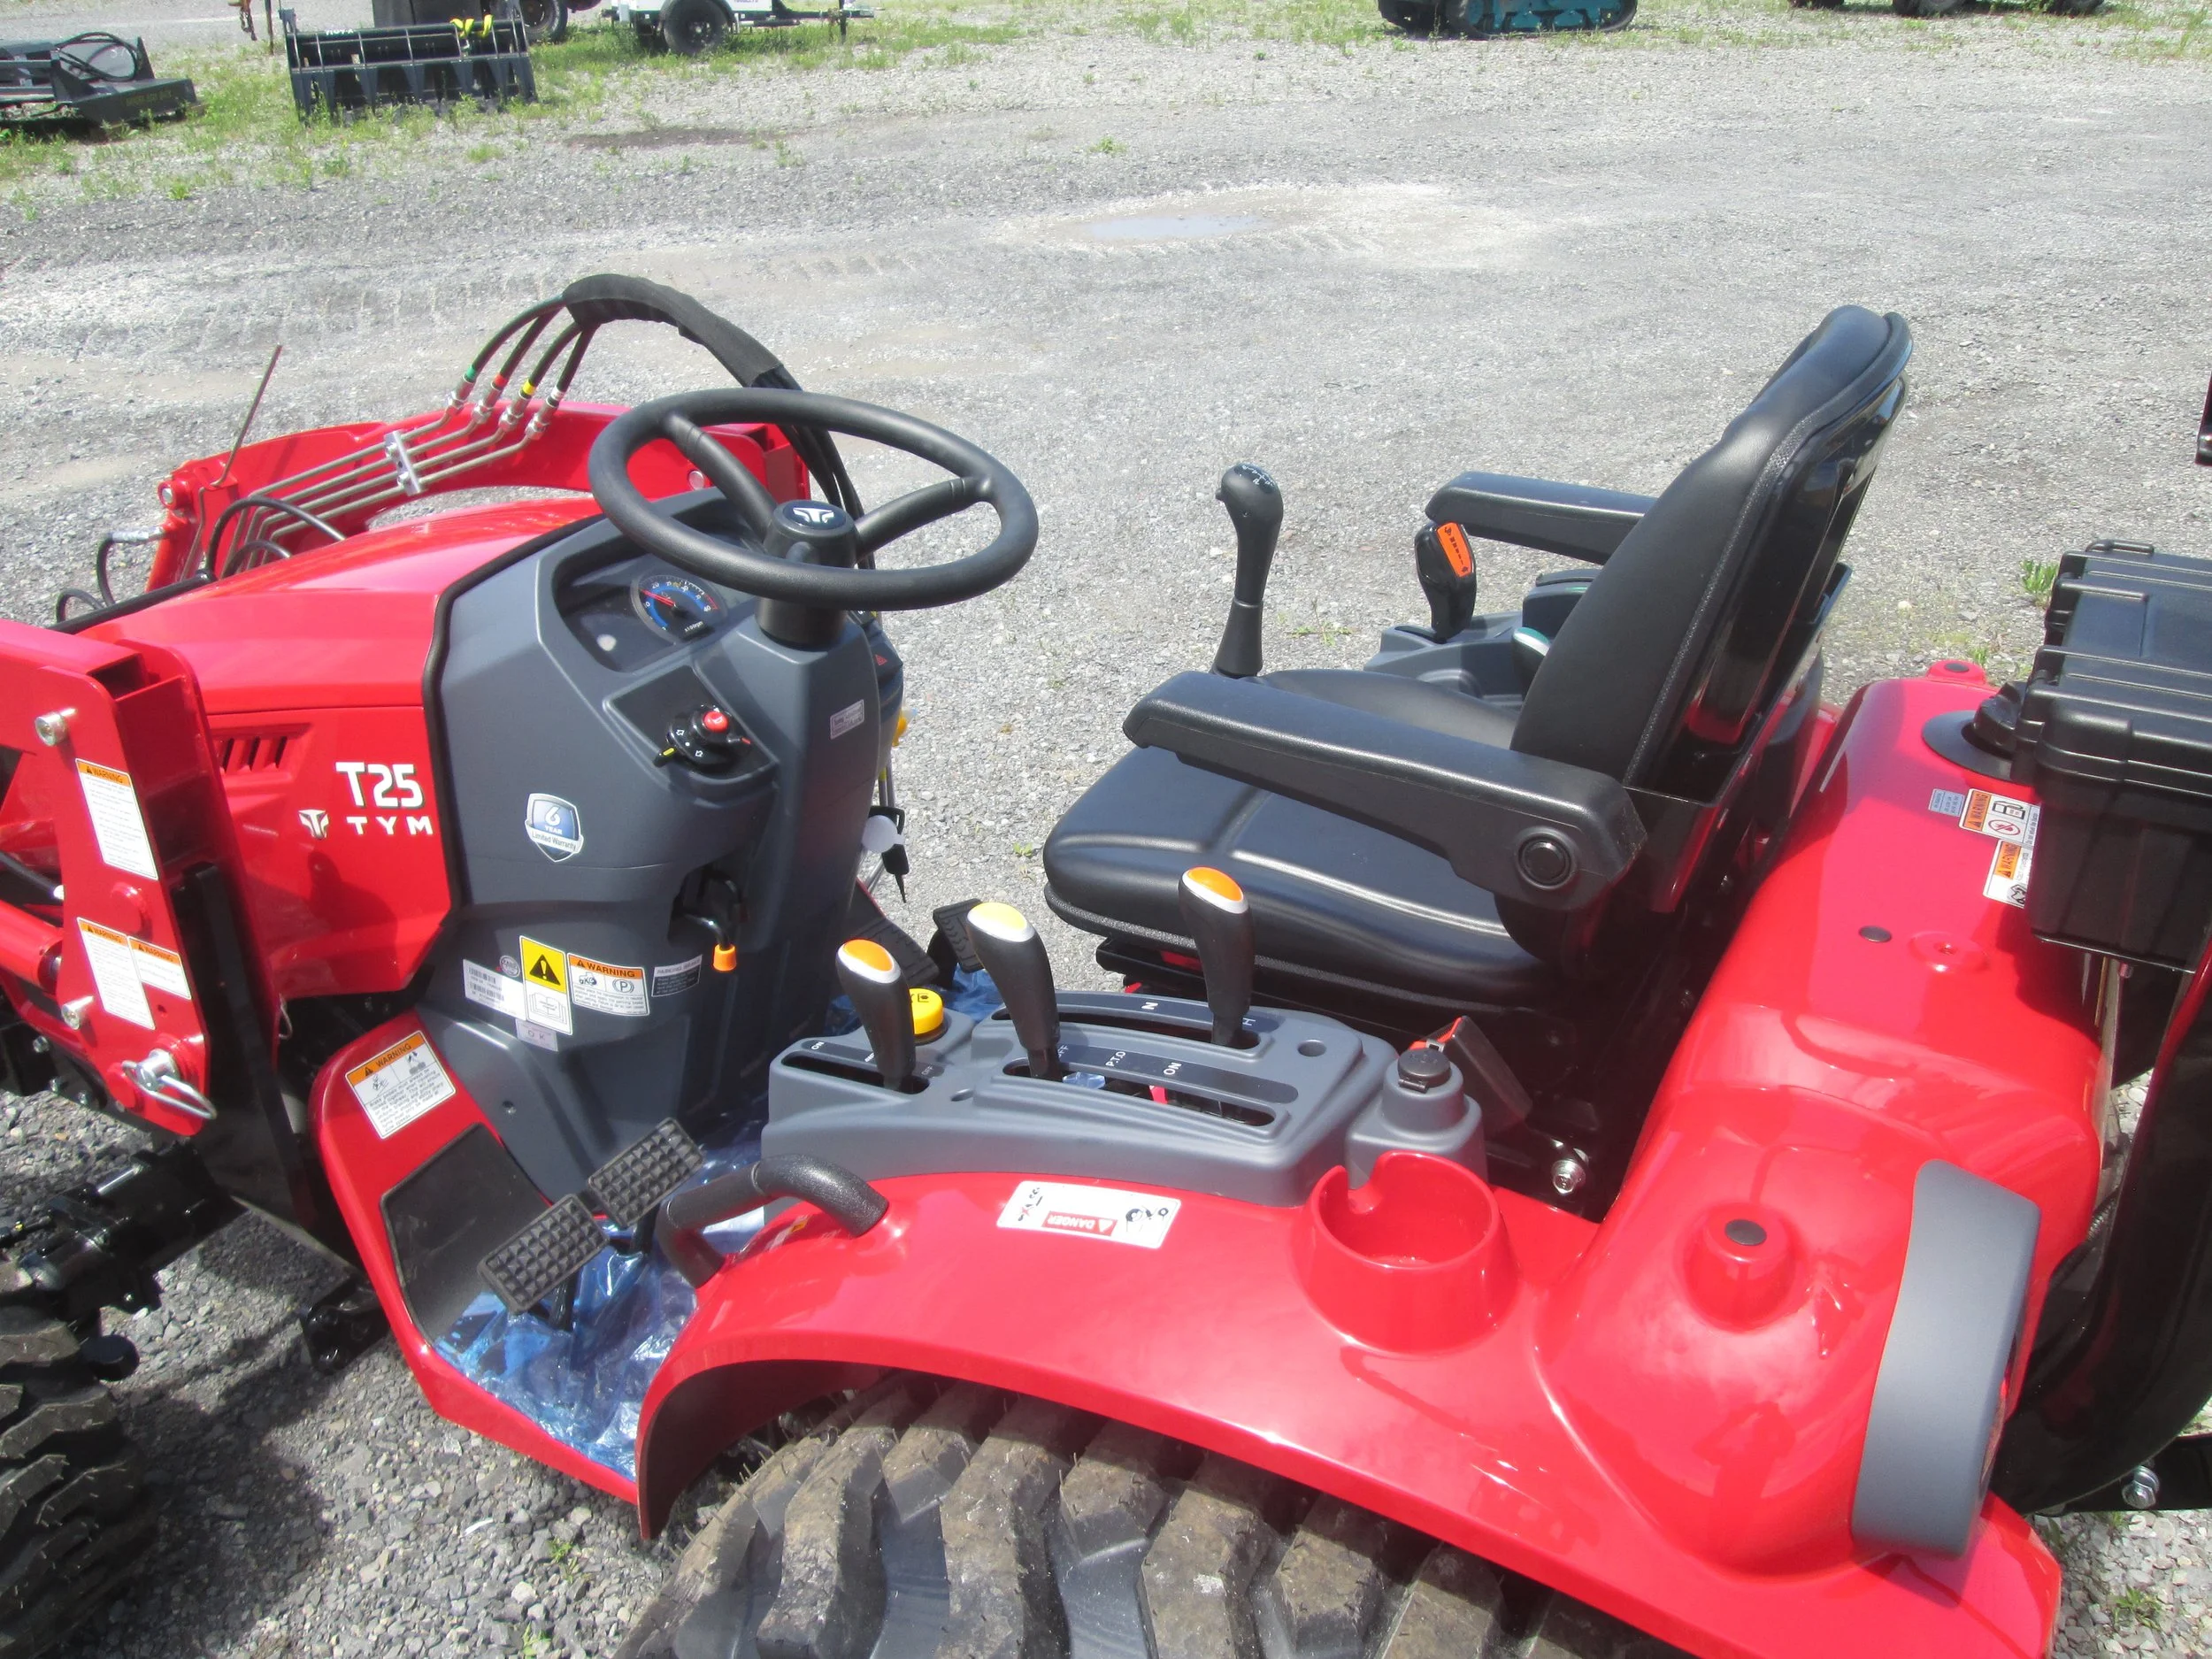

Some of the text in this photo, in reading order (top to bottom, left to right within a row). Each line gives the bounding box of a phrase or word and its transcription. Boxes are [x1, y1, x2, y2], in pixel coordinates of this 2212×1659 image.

[334, 761, 424, 808] T25
[545, 805, 561, 826] 6
[1973, 793, 1989, 818] WARNING
[346, 815, 434, 835] TYM
[544, 825, 563, 835] YEAR
[532, 831, 577, 852] Limited Warranty
[2001, 842, 2018, 870] WARNING
[587, 962, 635, 978] WARNING
[1141, 1002, 1159, 1010] N
[376, 1043, 412, 1068] WARNING
[810, 1041, 825, 1050] ON
[1163, 1062, 1182, 1075] ON
[1047, 1214, 1095, 1230] DANGER
